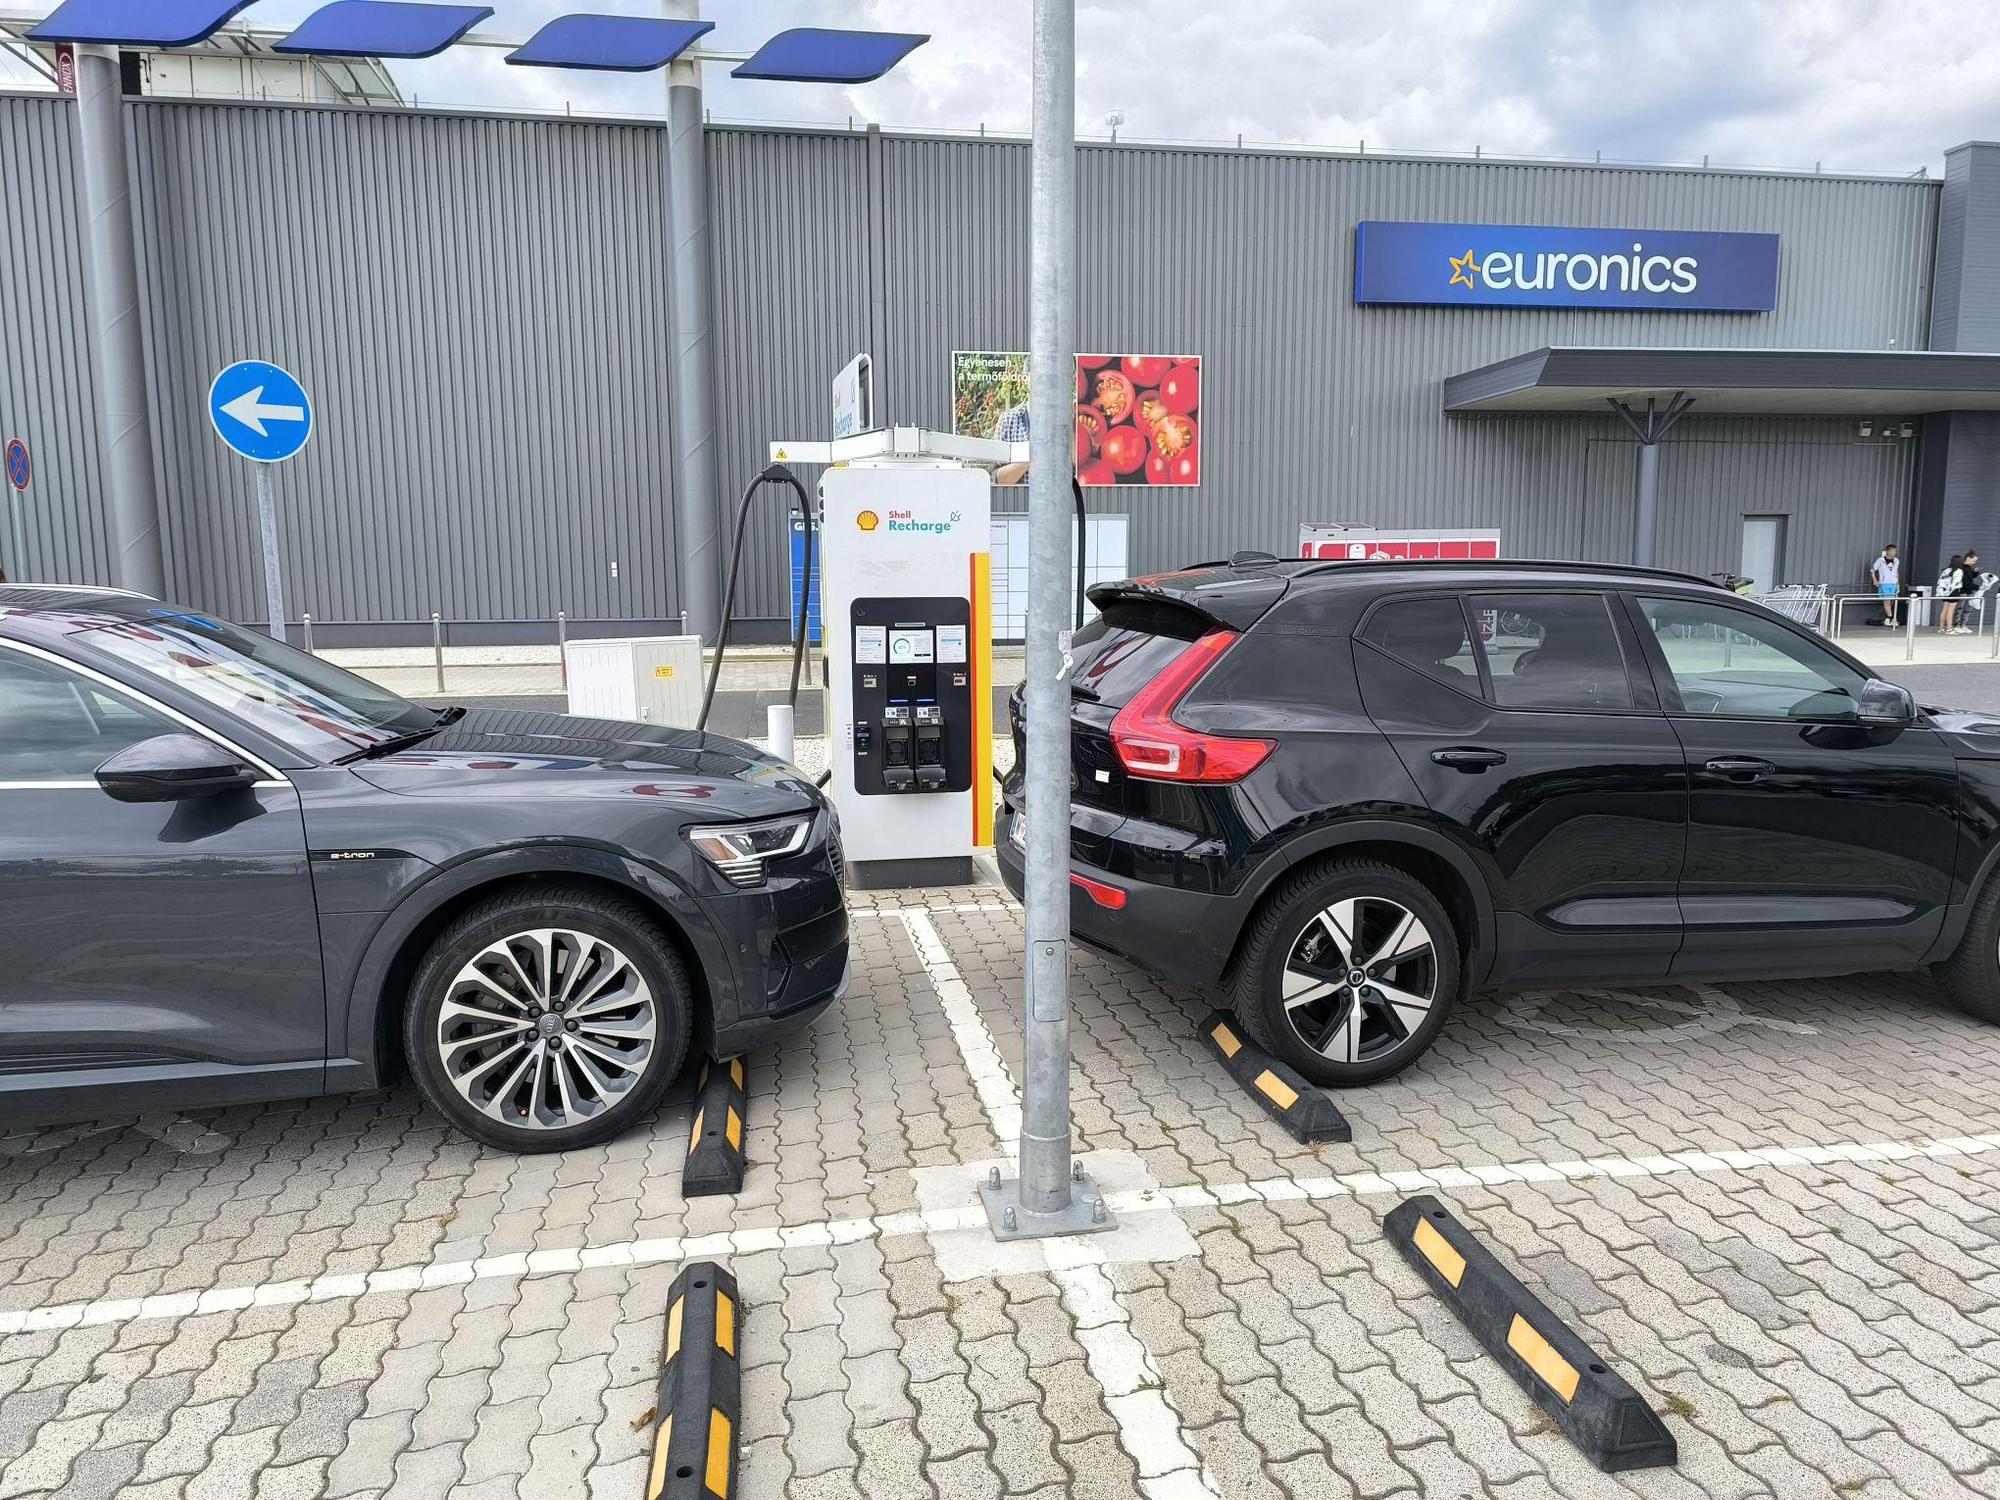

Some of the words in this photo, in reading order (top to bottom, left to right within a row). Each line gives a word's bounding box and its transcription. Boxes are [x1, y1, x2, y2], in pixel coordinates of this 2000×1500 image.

[61, 61, 73, 93] ENNOX
[1482, 243, 1698, 294] euronics
[958, 356, 1012, 368] Egyenesen
[888, 510, 912, 519] Shell
[888, 519, 951, 534] Recharge
